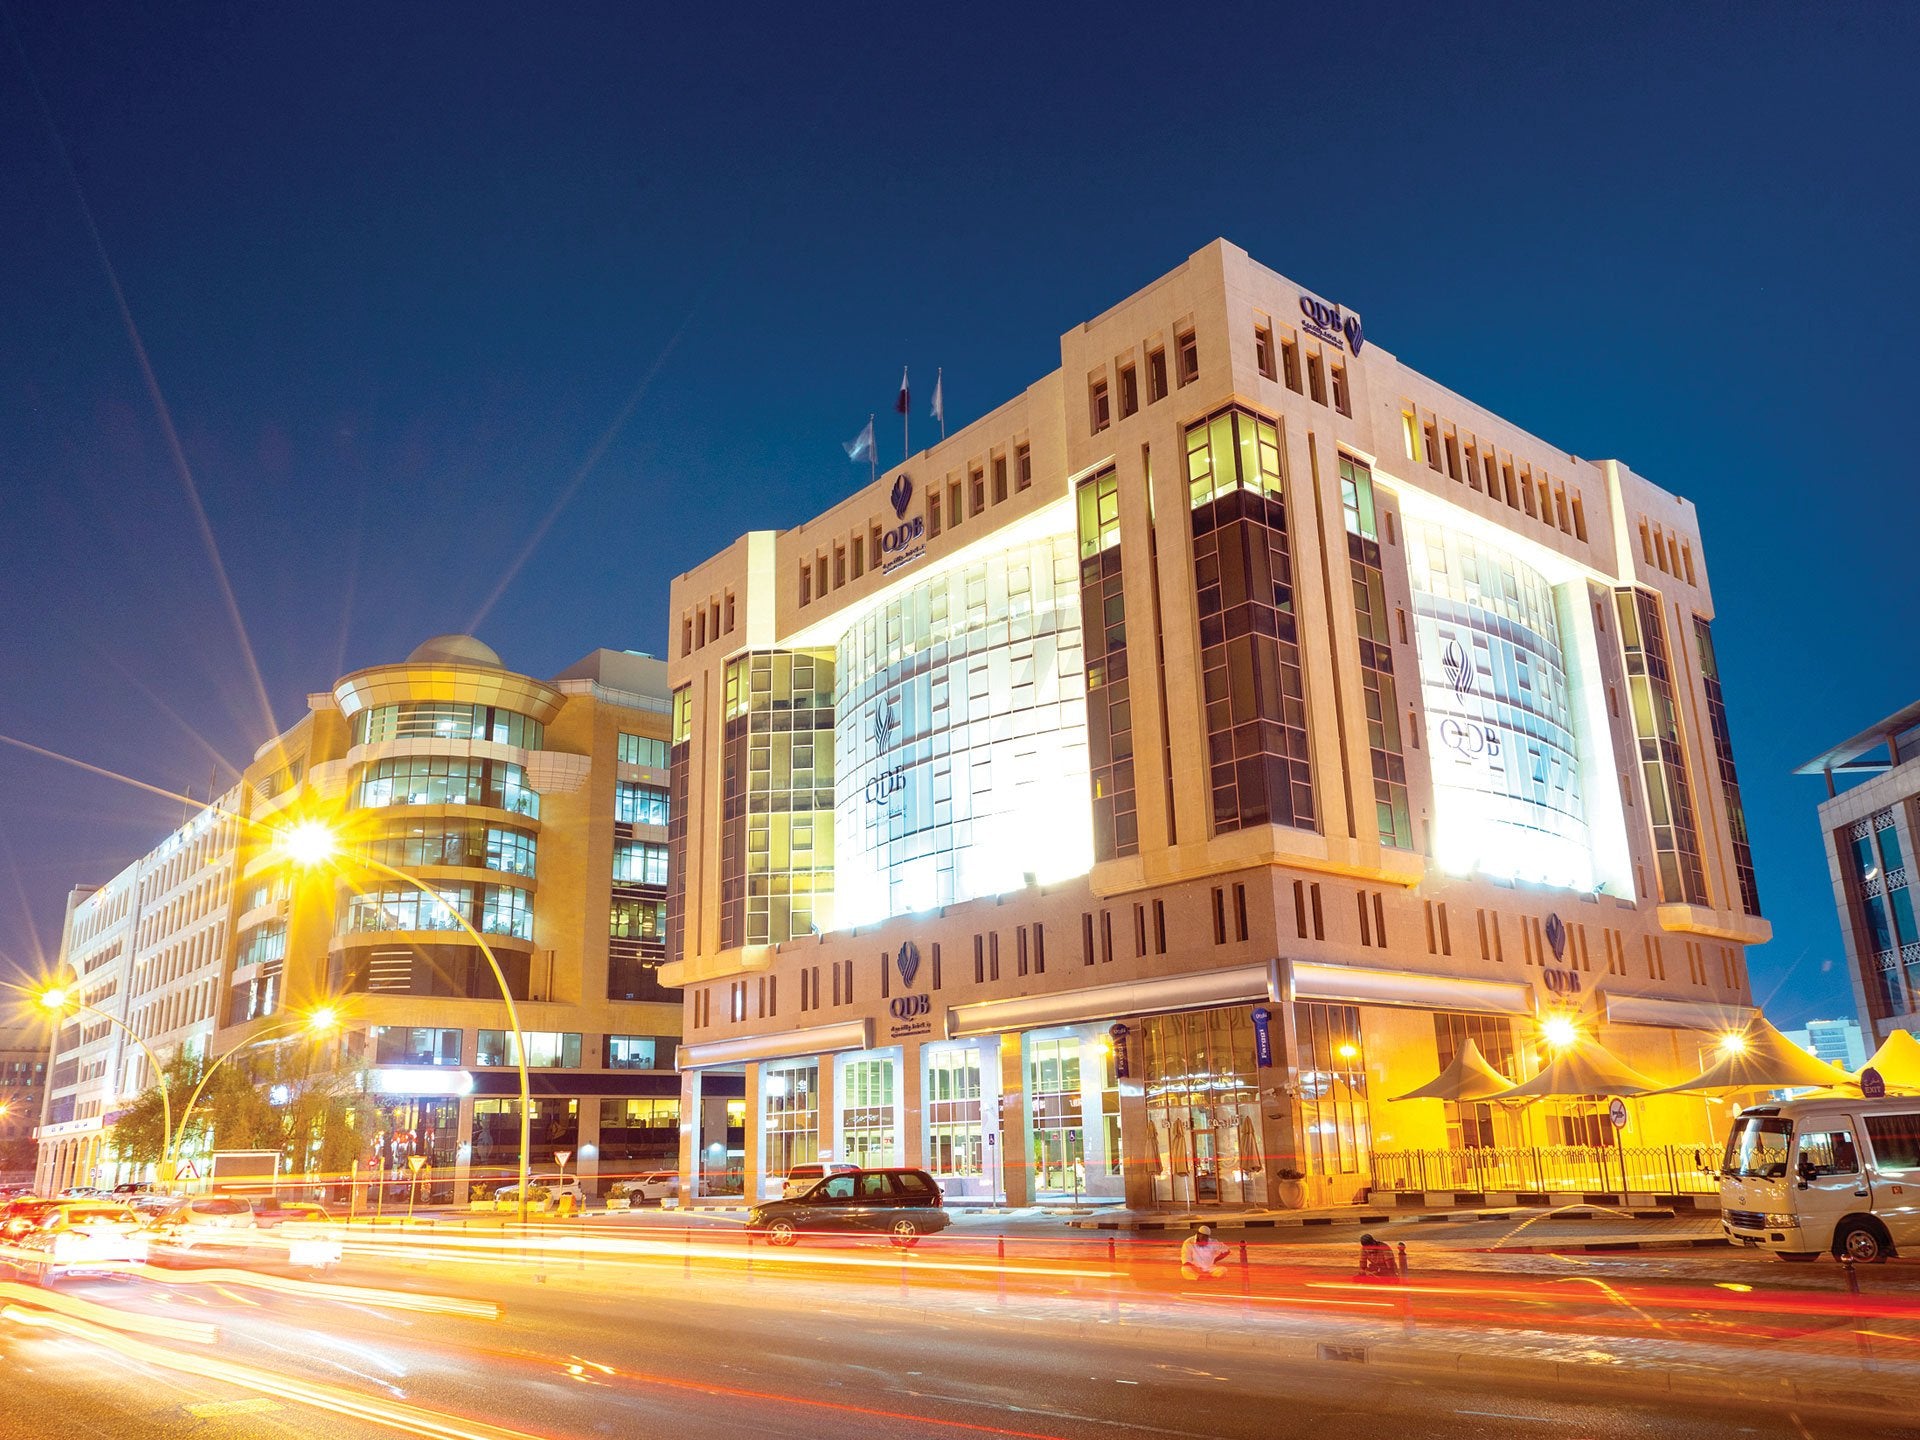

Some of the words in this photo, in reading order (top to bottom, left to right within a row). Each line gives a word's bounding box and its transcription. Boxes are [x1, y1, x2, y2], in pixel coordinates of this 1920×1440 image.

[1300, 296, 1342, 332] QDB
[882, 516, 924, 553] QDB
[1440, 719, 1500, 759] QDB
[866, 765, 906, 805] QDB
[1543, 968, 1581, 997] QDB
[890, 994, 930, 1021] QDB
